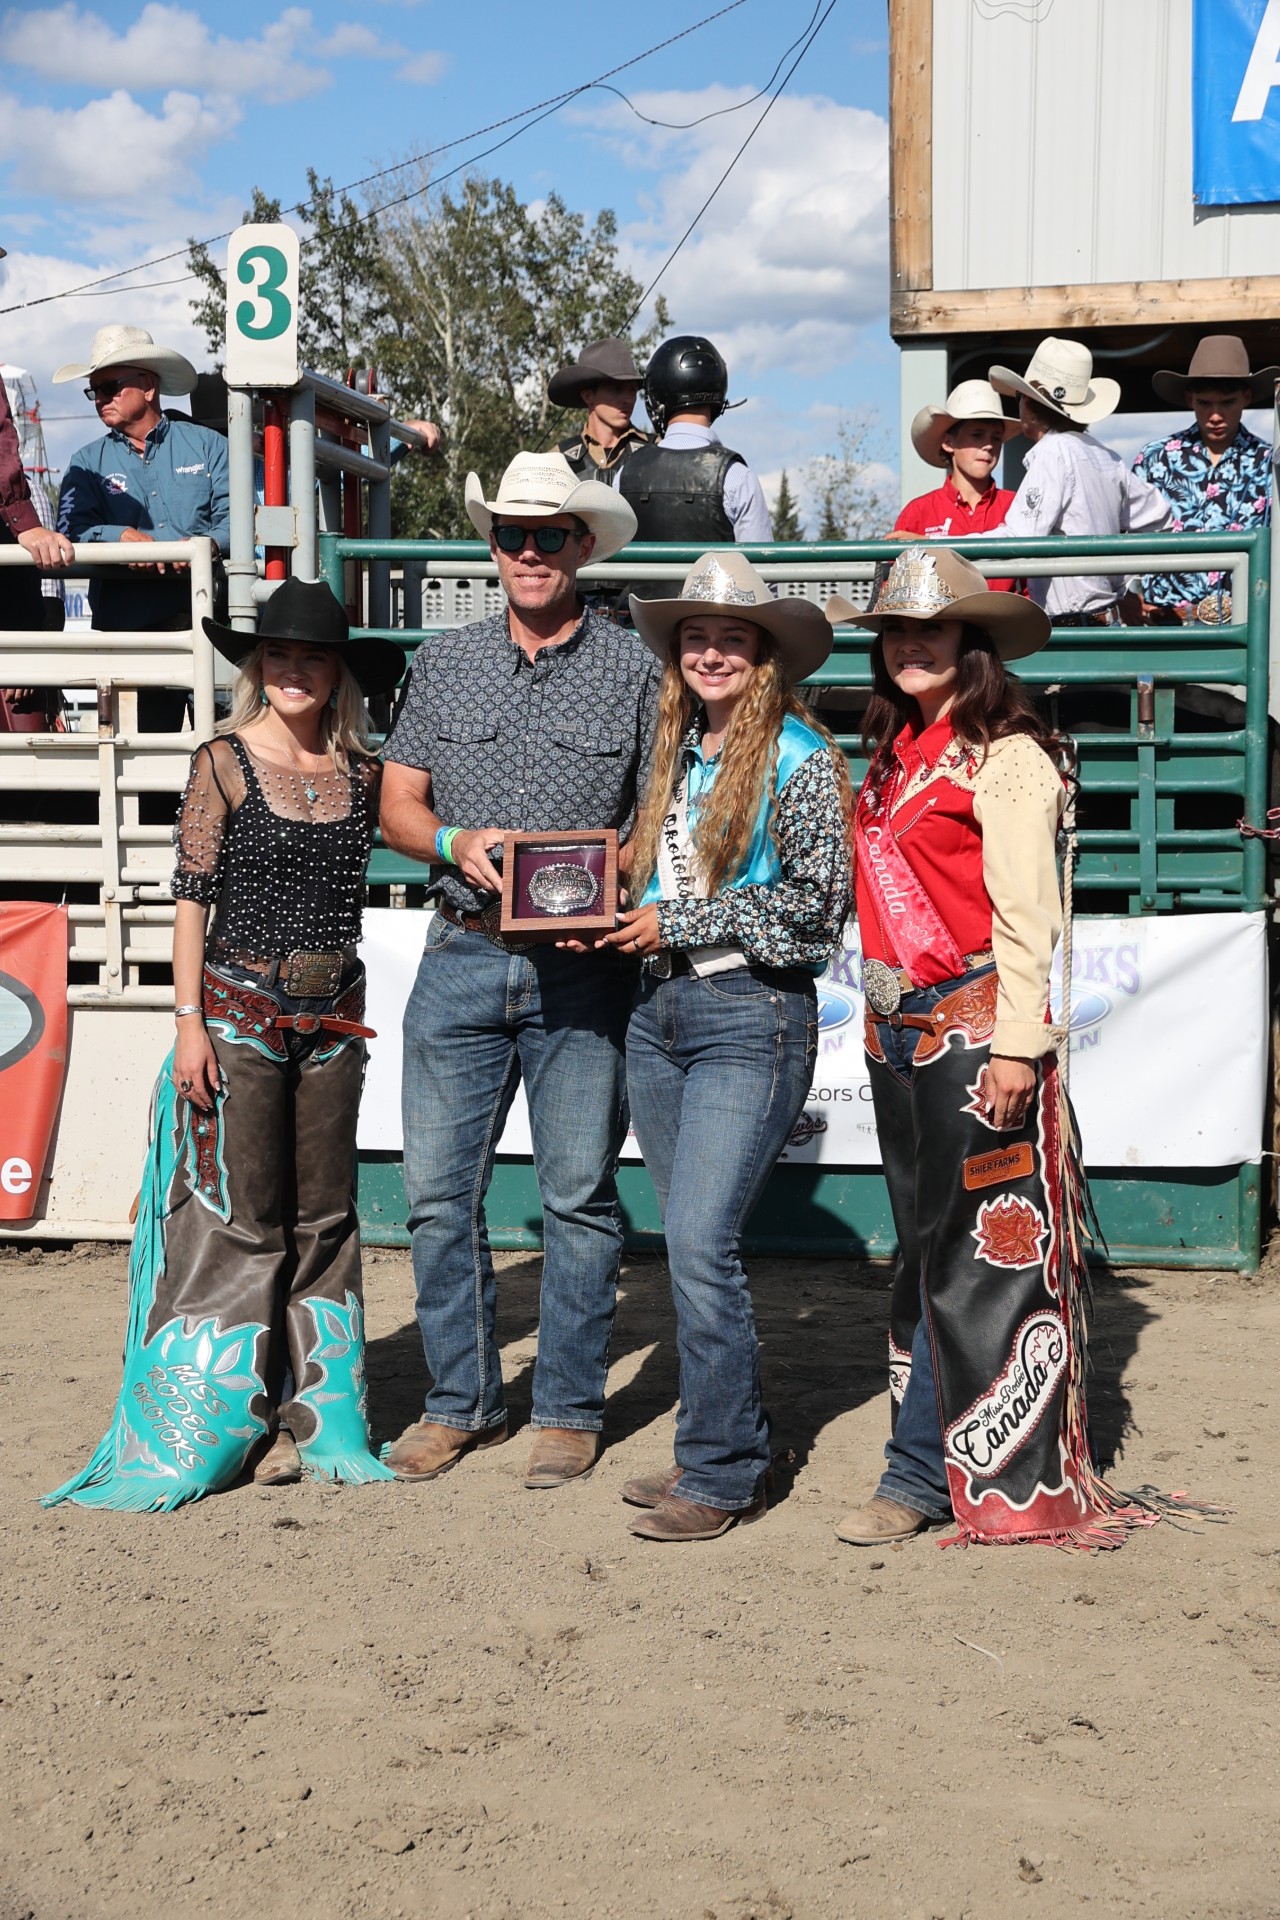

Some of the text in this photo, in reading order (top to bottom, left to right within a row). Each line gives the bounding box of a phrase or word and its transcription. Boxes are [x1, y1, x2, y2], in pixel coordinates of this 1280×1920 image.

[236, 245, 292, 341] 3
[175, 462, 206, 475] Wrangler
[865, 826, 909, 920] Canada
[900, 920, 936, 948] 2024
[0, 1157, 32, 1194] e
[970, 1153, 1020, 1176] SHIER FARMS
[132, 1382, 206, 1470] OKOTOKS
[147, 1365, 219, 1446] RODEO
[167, 1364, 231, 1416] MISS
[952, 1320, 1063, 1468] Canada
[978, 1364, 1026, 1427] Miss Rodeo
